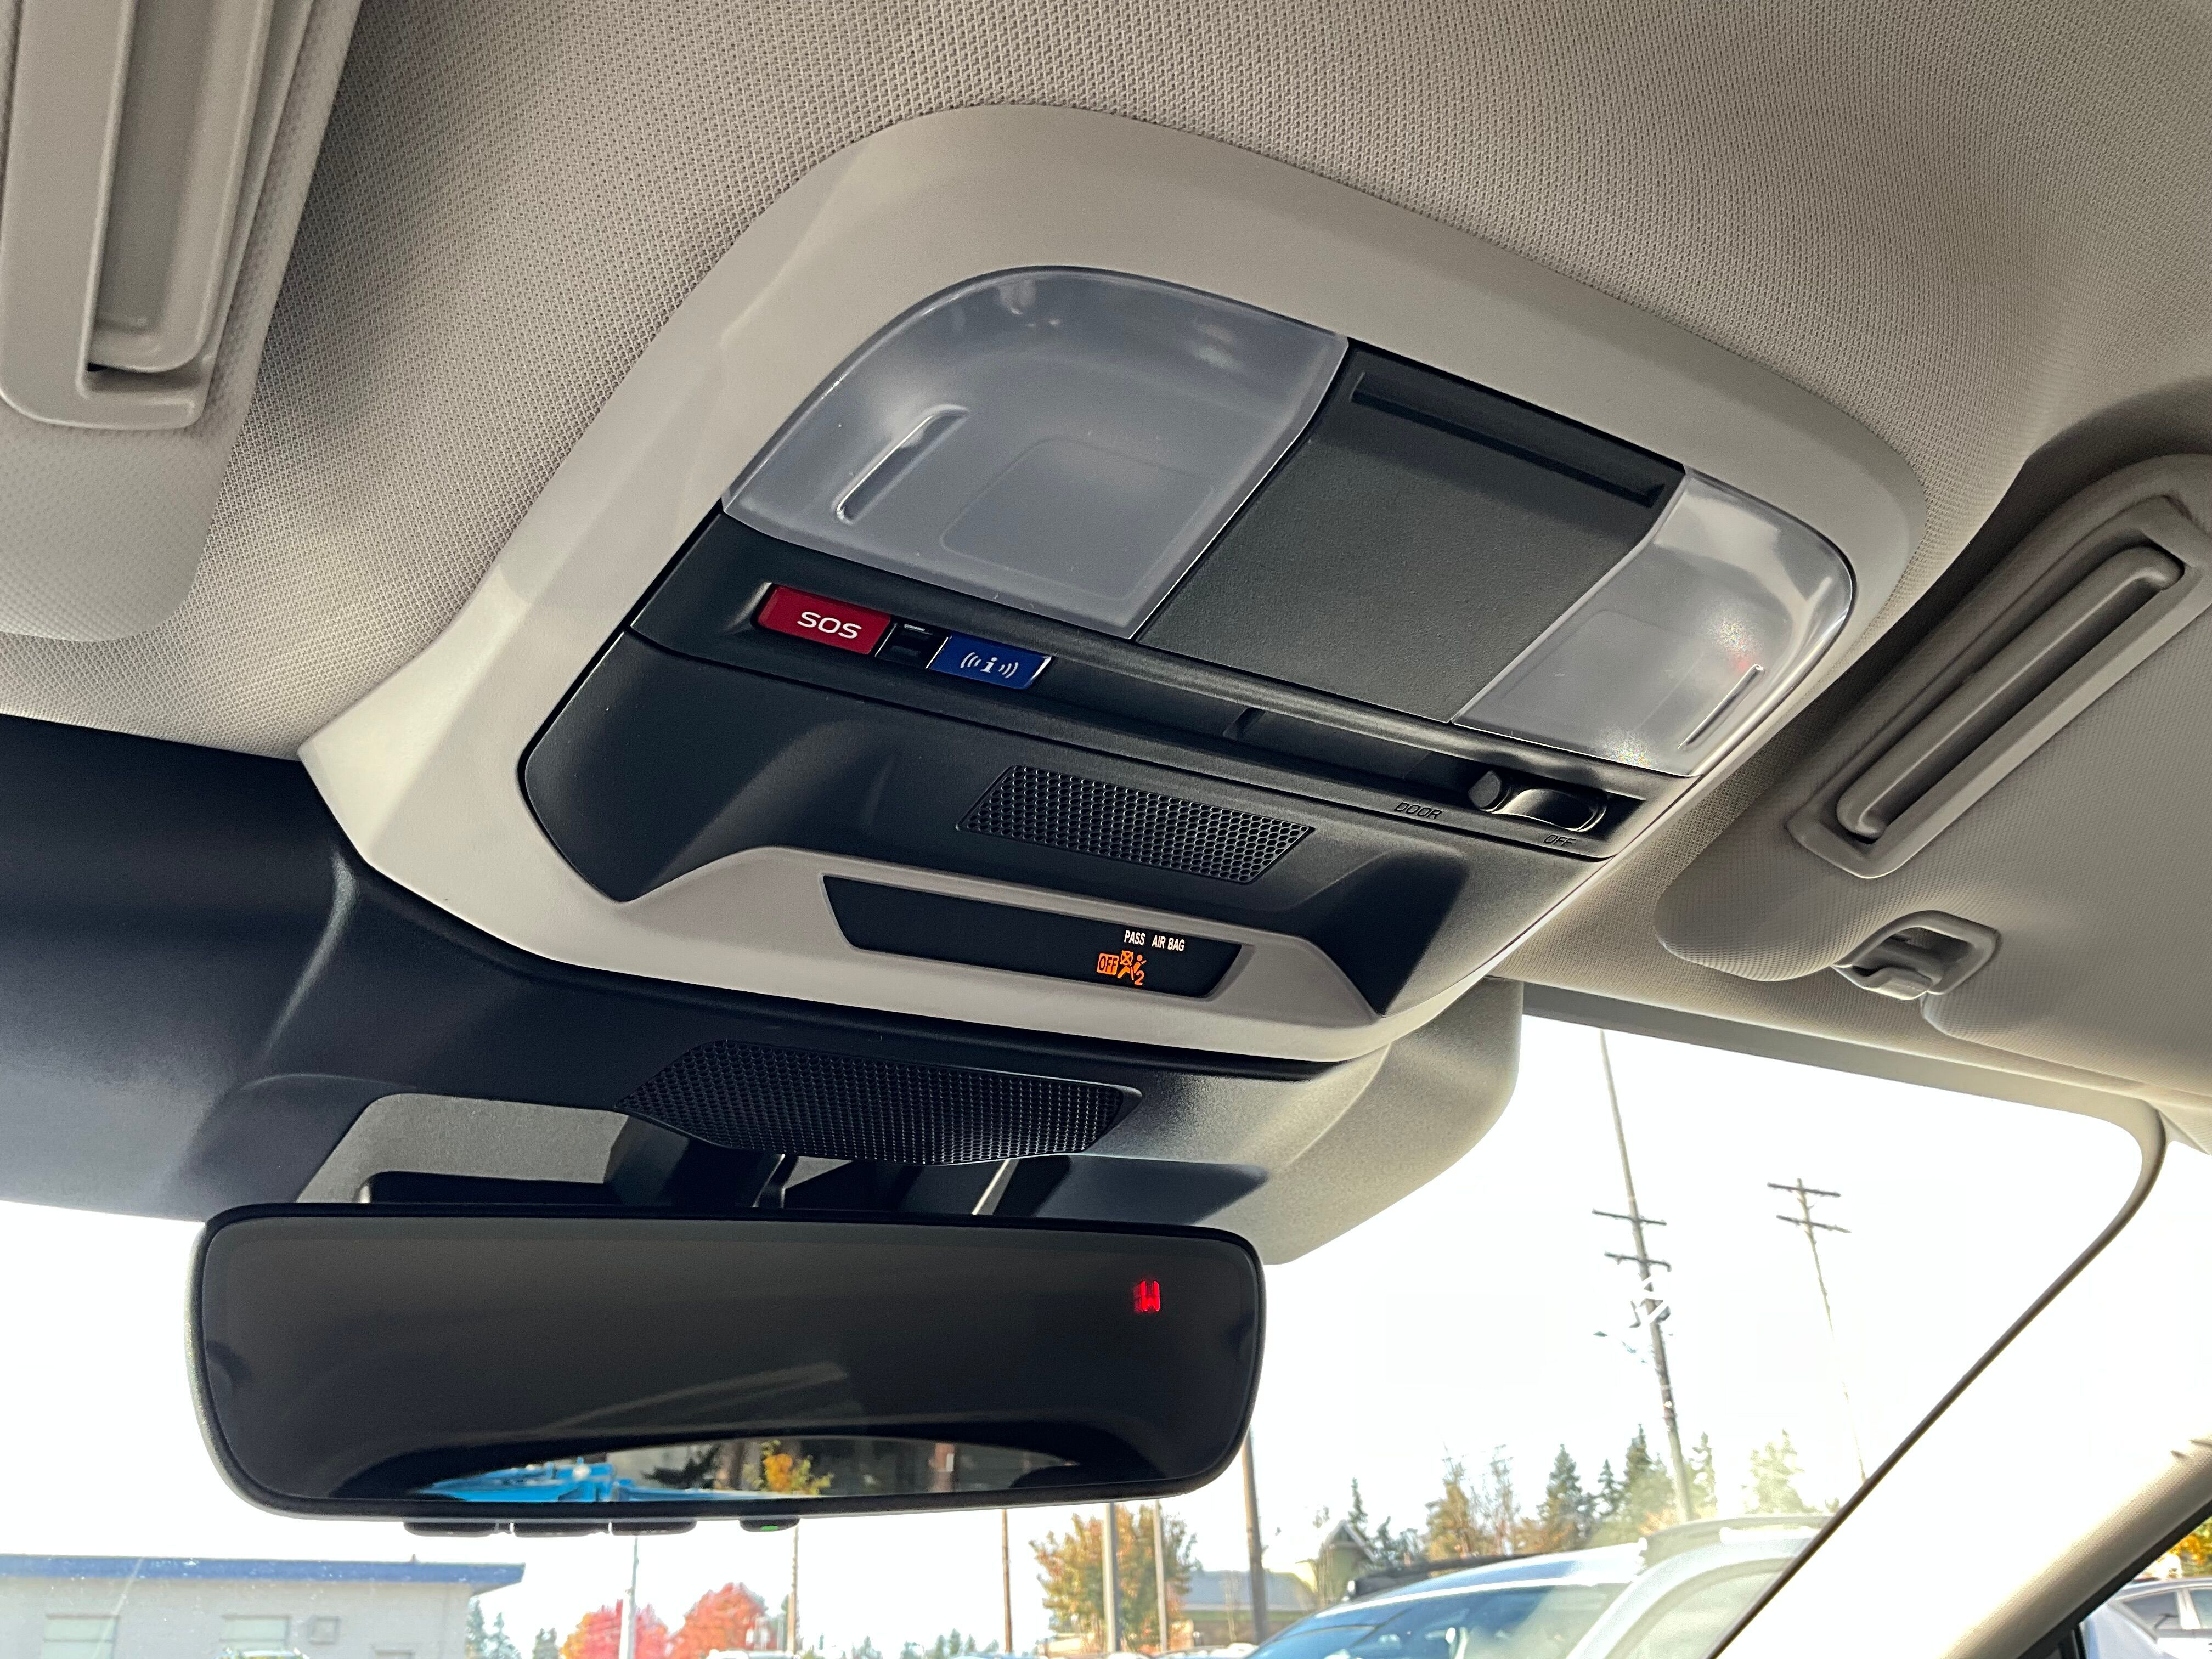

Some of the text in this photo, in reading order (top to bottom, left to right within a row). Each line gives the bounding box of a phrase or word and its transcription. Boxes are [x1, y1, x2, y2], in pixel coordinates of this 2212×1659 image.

[797, 611, 862, 639] SOS
[1394, 802, 1442, 820] DOOR
[1544, 834, 1576, 847] OFF
[1124, 930, 1185, 952] PASS AIR BAG
[1098, 955, 1118, 973] OFF
[1134, 970, 1144, 986] 2
